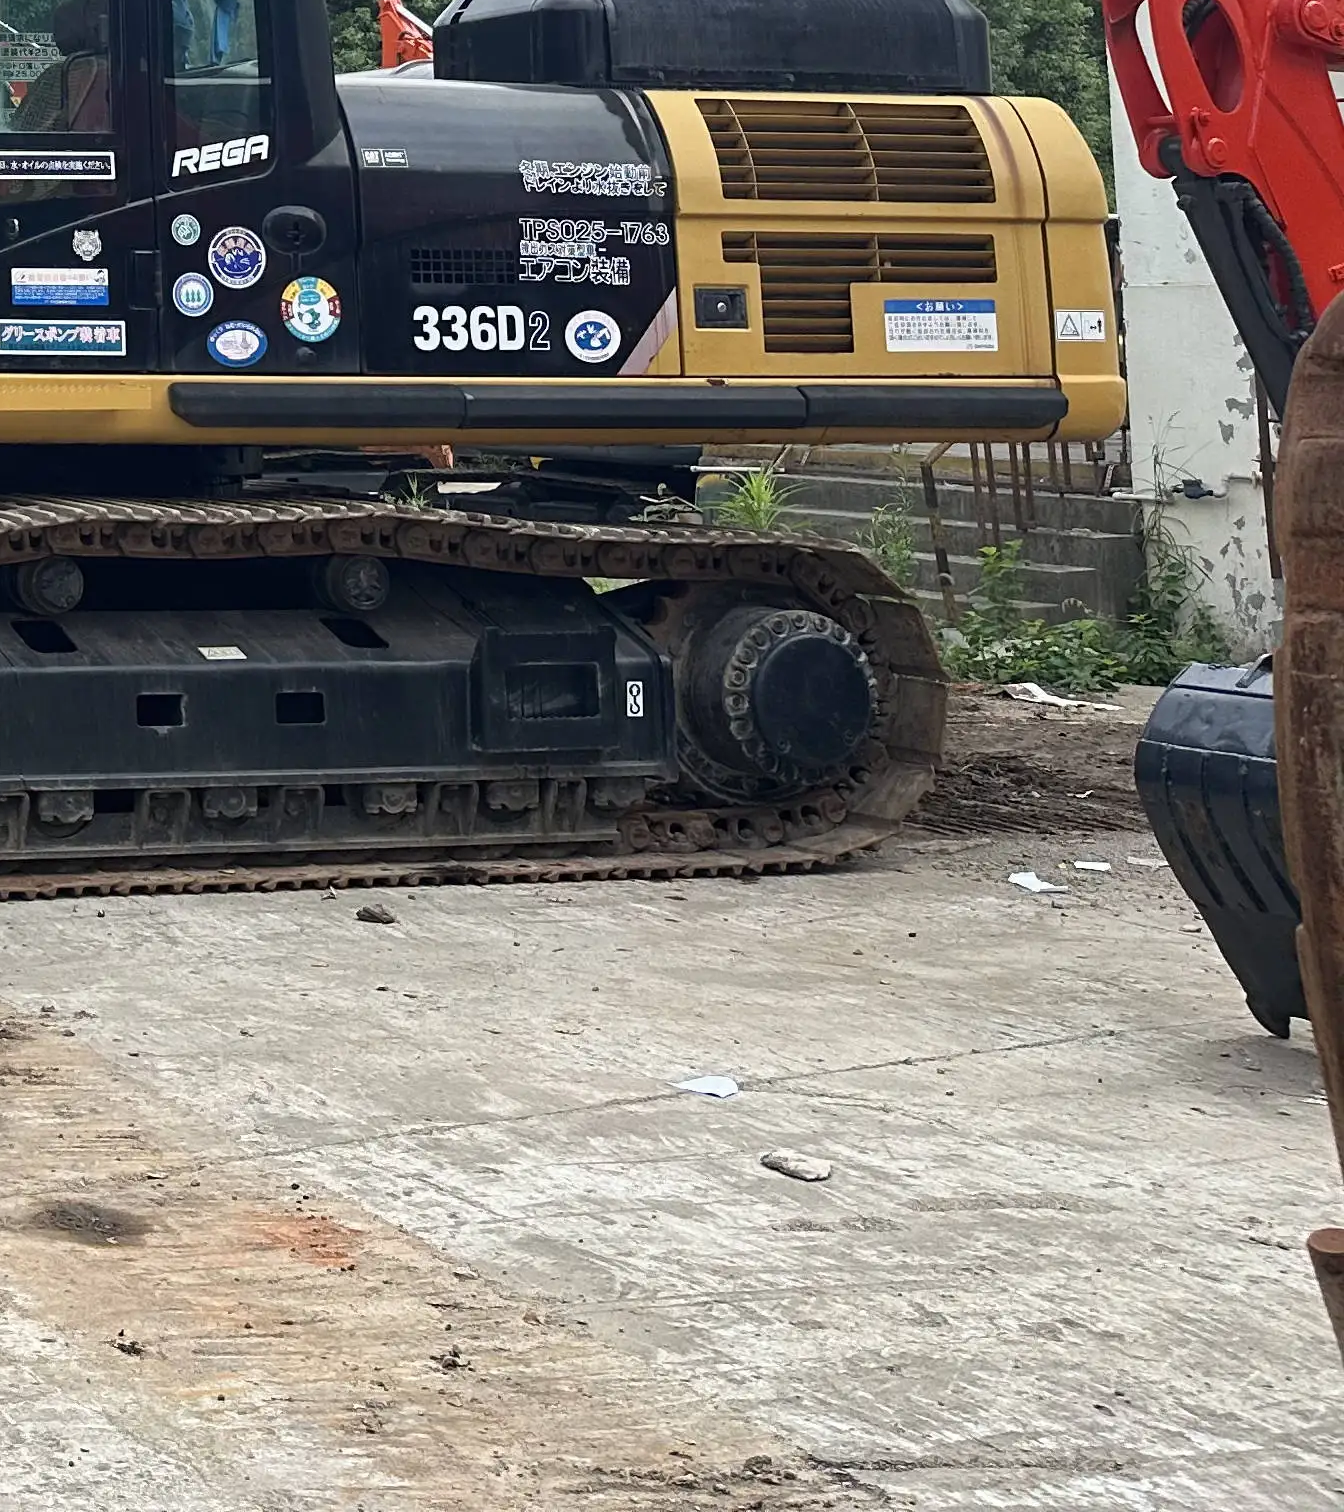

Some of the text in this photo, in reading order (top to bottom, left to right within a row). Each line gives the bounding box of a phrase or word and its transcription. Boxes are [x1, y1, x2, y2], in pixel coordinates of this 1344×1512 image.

[171, 134, 270, 177] REGA
[518, 256, 631, 286] エアコン装備
[1, 325, 121, 344] グリースポンプ装着車
